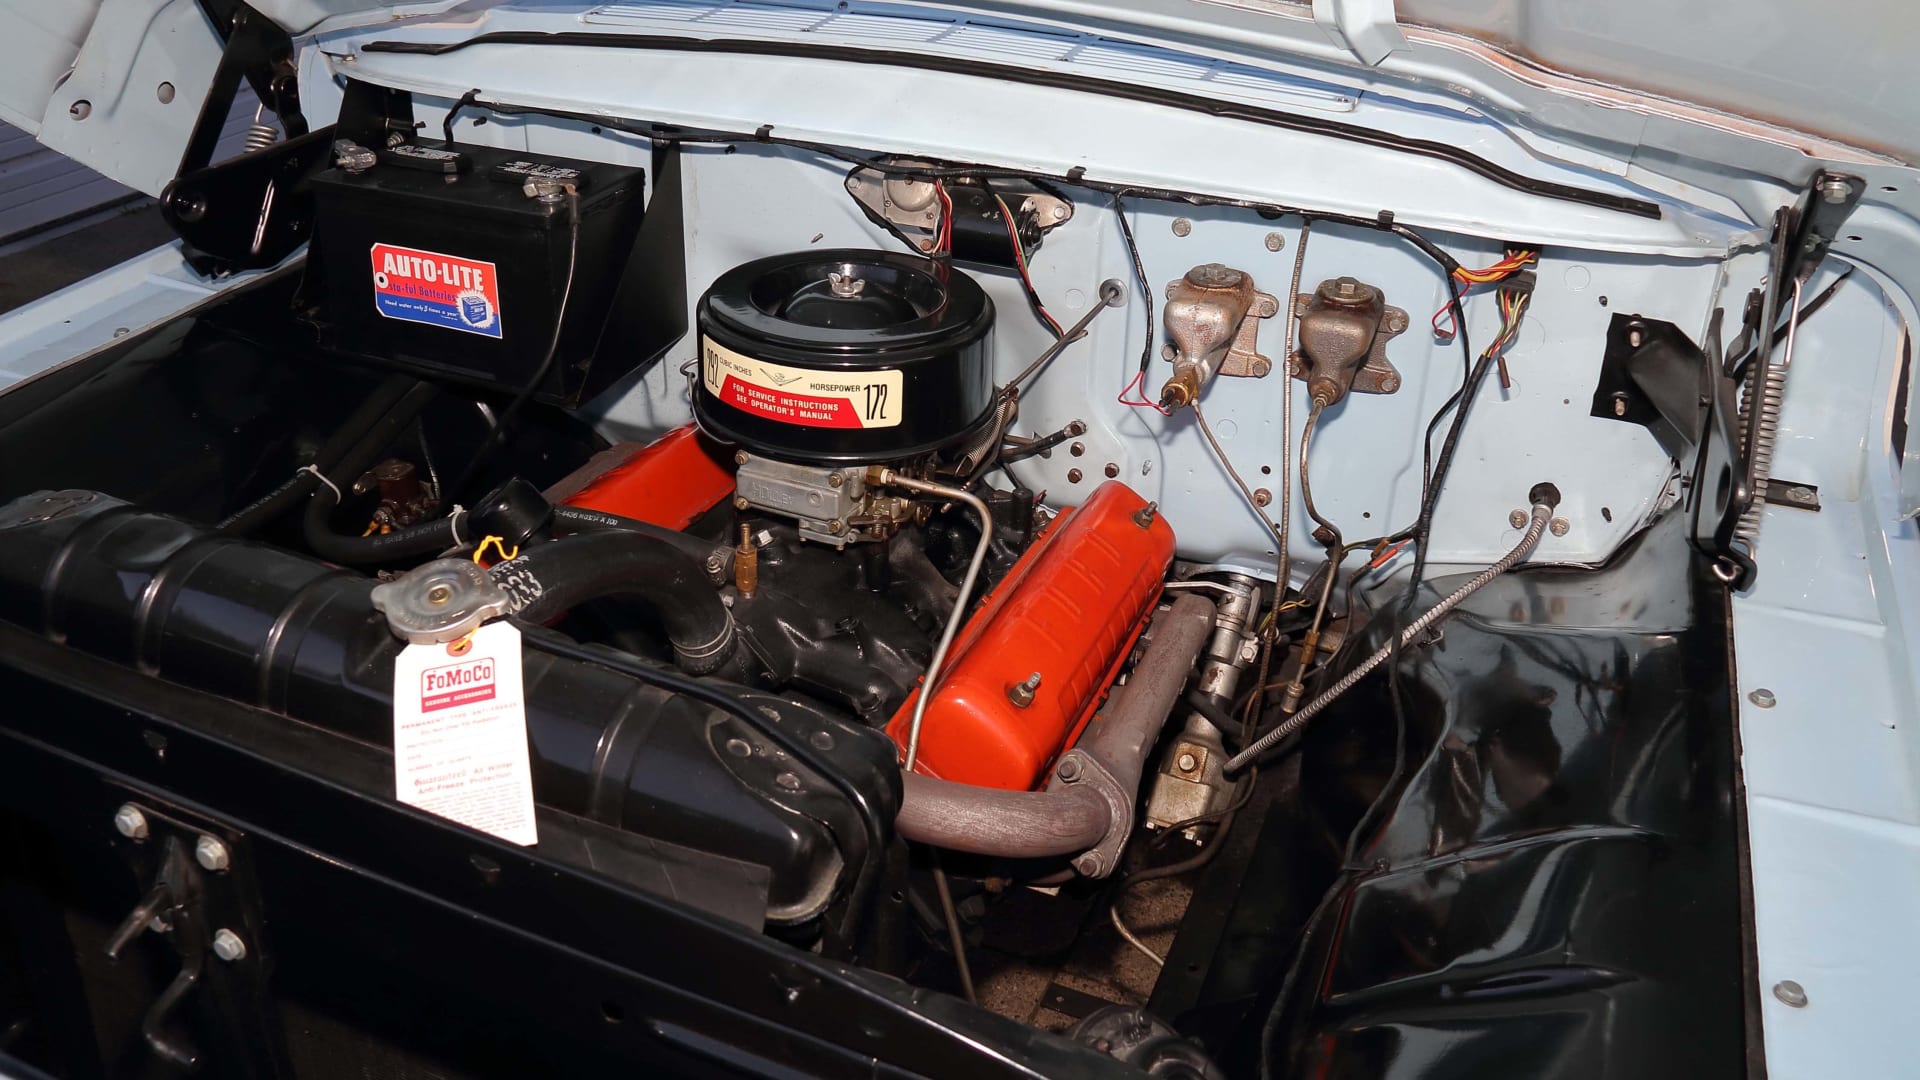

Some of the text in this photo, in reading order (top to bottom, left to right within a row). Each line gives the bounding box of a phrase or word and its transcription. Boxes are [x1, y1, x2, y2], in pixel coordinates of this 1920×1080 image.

[384, 252, 485, 291] AUTO-LITE
[706, 347, 720, 389] 292
[719, 357, 752, 377] CUBIC INCHES
[732, 382, 839, 412] FOR SERVICE INSTRUCTIONS
[809, 382, 861, 393] HORSEPOWER
[863, 383, 888, 420] 172
[736, 393, 833, 420] SEE OPERATOR'S MANUAL
[426, 665, 491, 691] FoMoCo
